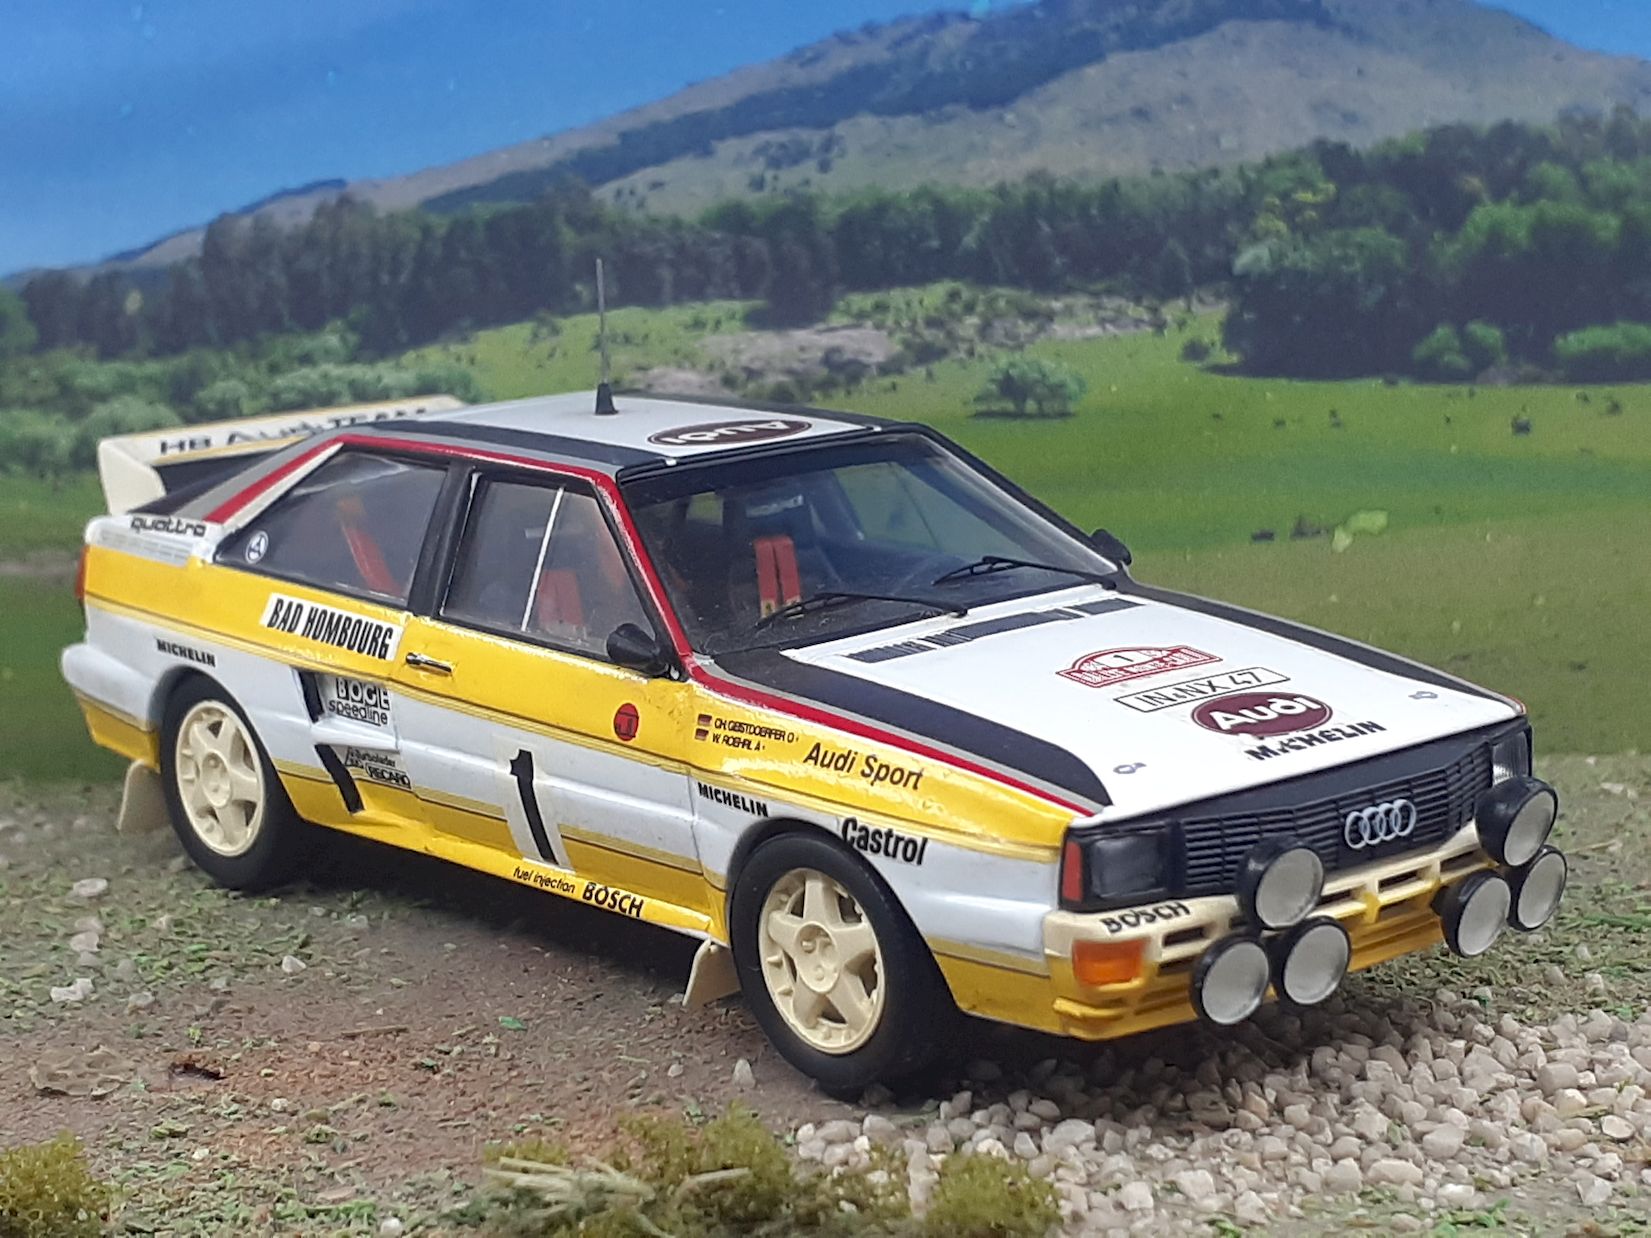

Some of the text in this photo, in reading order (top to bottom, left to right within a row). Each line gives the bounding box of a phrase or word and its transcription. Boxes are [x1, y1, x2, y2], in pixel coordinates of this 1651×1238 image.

[130, 516, 207, 537] quattro
[267, 598, 395, 660] BAD HOMBOURG
[157, 639, 216, 667] MICHELIN
[335, 677, 391, 711] BOGE
[328, 699, 388, 726] speedline
[803, 742, 924, 791] Audi Sport
[510, 748, 560, 866] 1
[697, 782, 769, 818] MICHELIN
[841, 816, 929, 866] Castrol
[513, 866, 645, 918] fuel injection BOSCH
[1099, 901, 1191, 934] BOSCH
